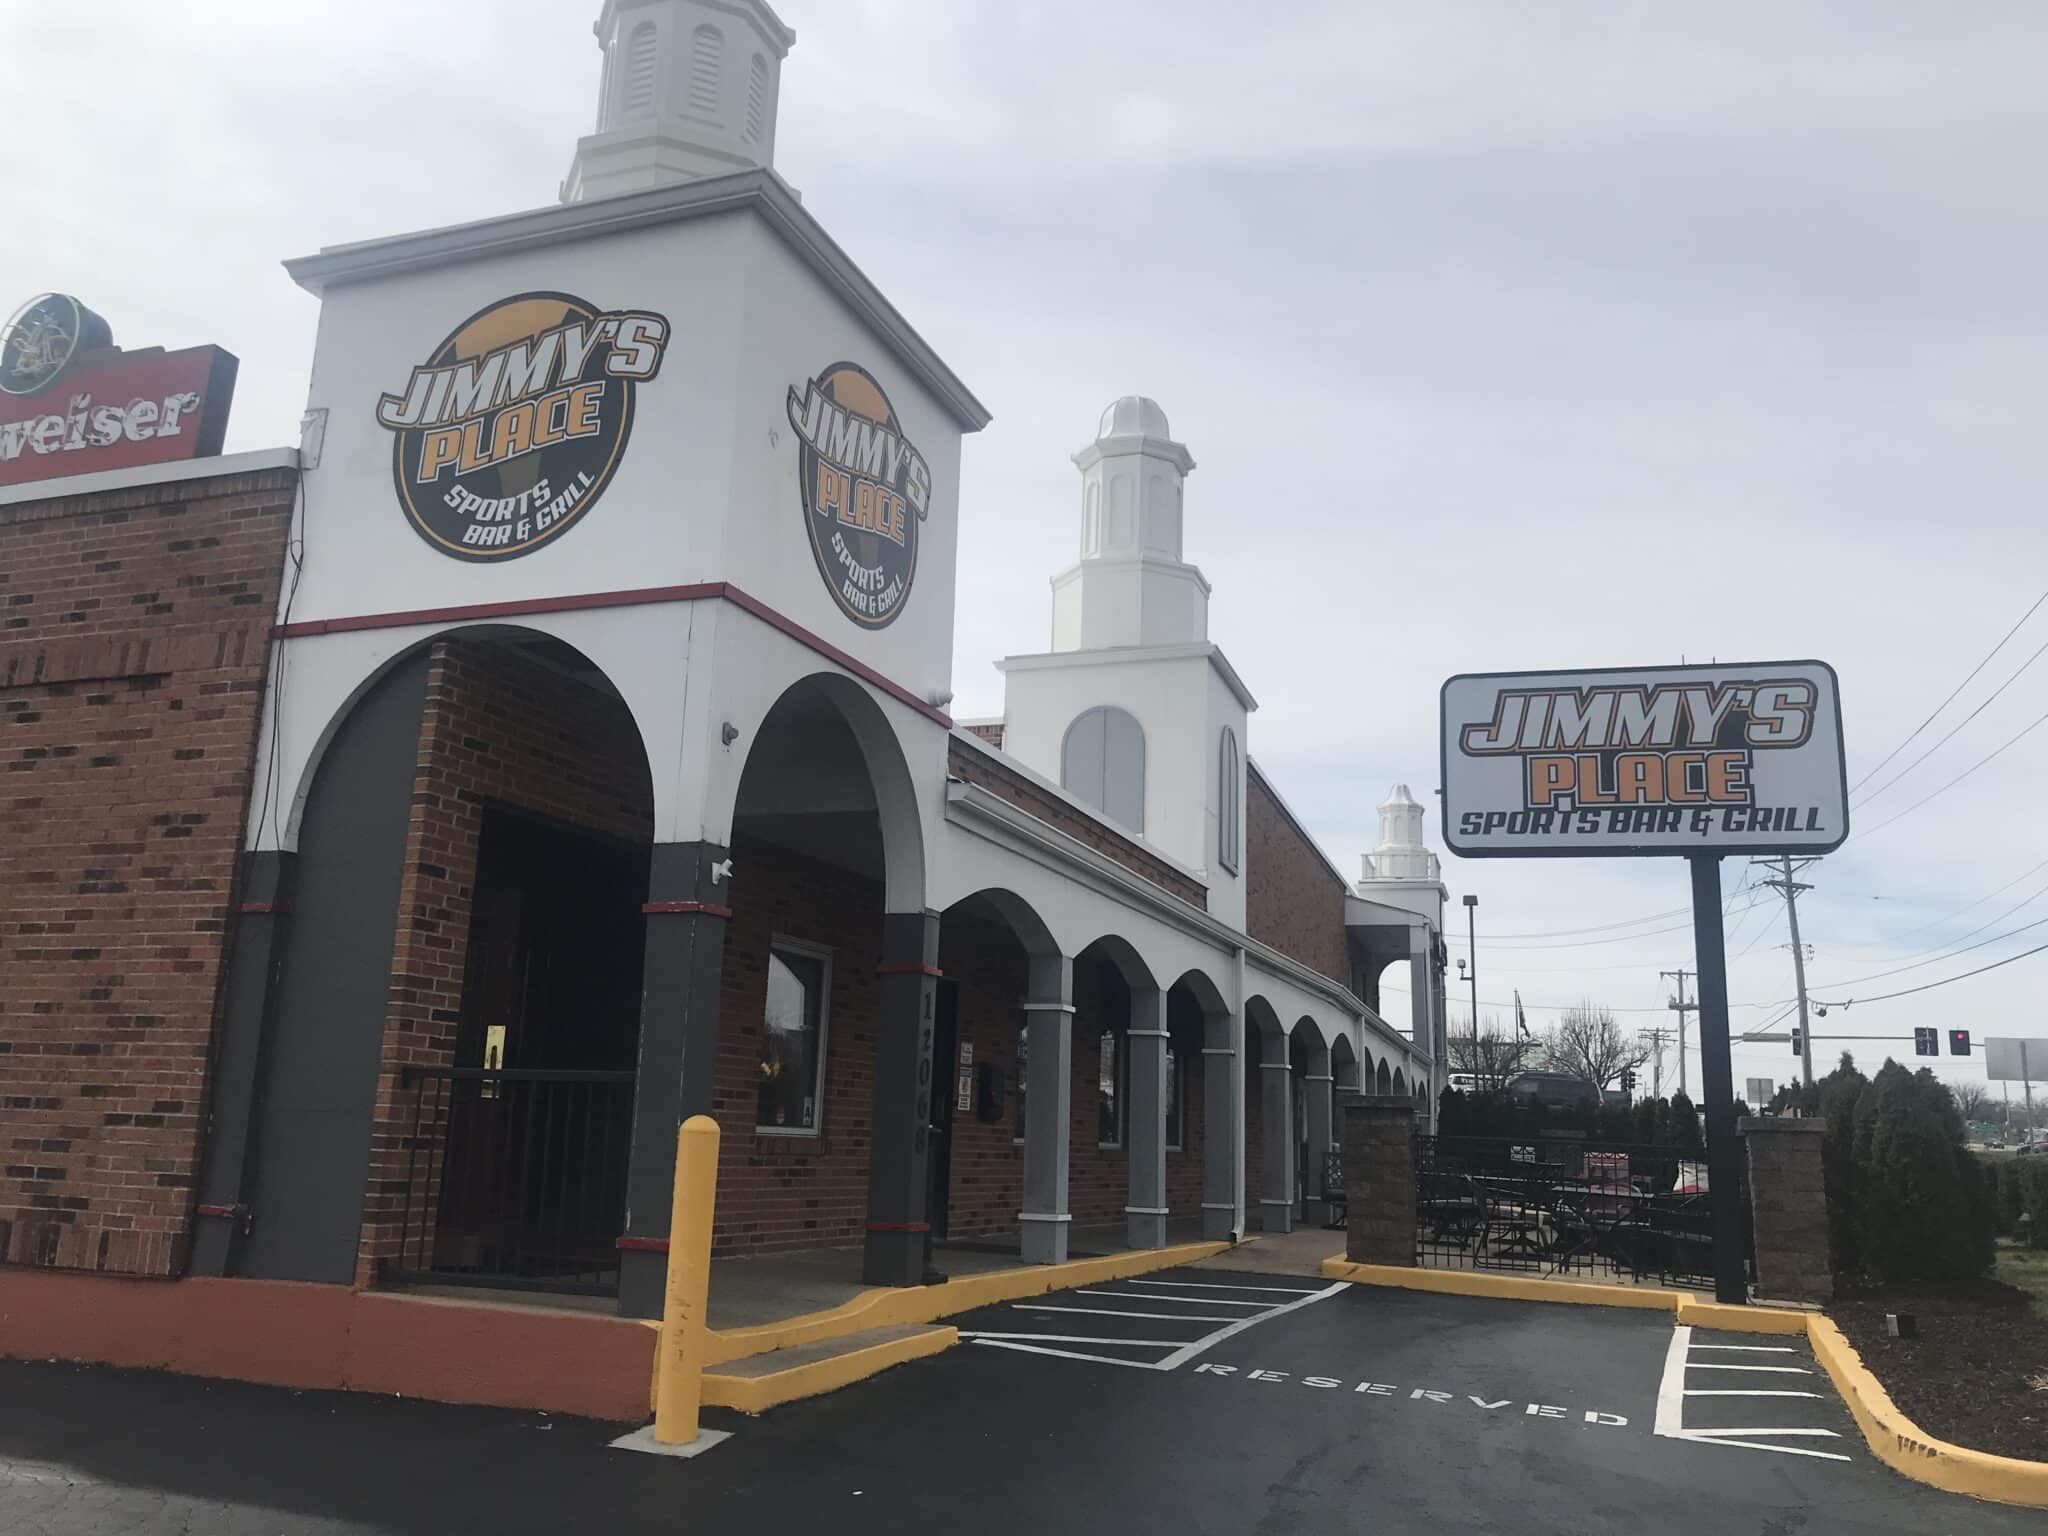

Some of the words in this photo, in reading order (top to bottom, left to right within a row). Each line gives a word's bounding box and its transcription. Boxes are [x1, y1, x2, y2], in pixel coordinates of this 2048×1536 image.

[378, 313, 669, 429] JIMMY'S
[417, 380, 605, 484] PLACE
[788, 382, 931, 517] JIMMY'S
[443, 479, 552, 521] SPORTS
[462, 524, 512, 546] BAR
[517, 519, 532, 541] &
[536, 471, 596, 531] GRILL
[816, 458, 905, 548] PLACE
[831, 532, 884, 591] SPORTS
[843, 579, 867, 613] BAR
[869, 594, 877, 617] &
[878, 574, 903, 612] GRILL
[1461, 681, 1815, 754] JIMMY'S
[1526, 749, 1753, 810] PLACE
[1459, 810, 1598, 836] SPORTS
[1607, 808, 1682, 834] BAR
[1690, 808, 1714, 837] &
[1721, 807, 1825, 832] GRILL
[1193, 1363, 1628, 1427] RESERVED
